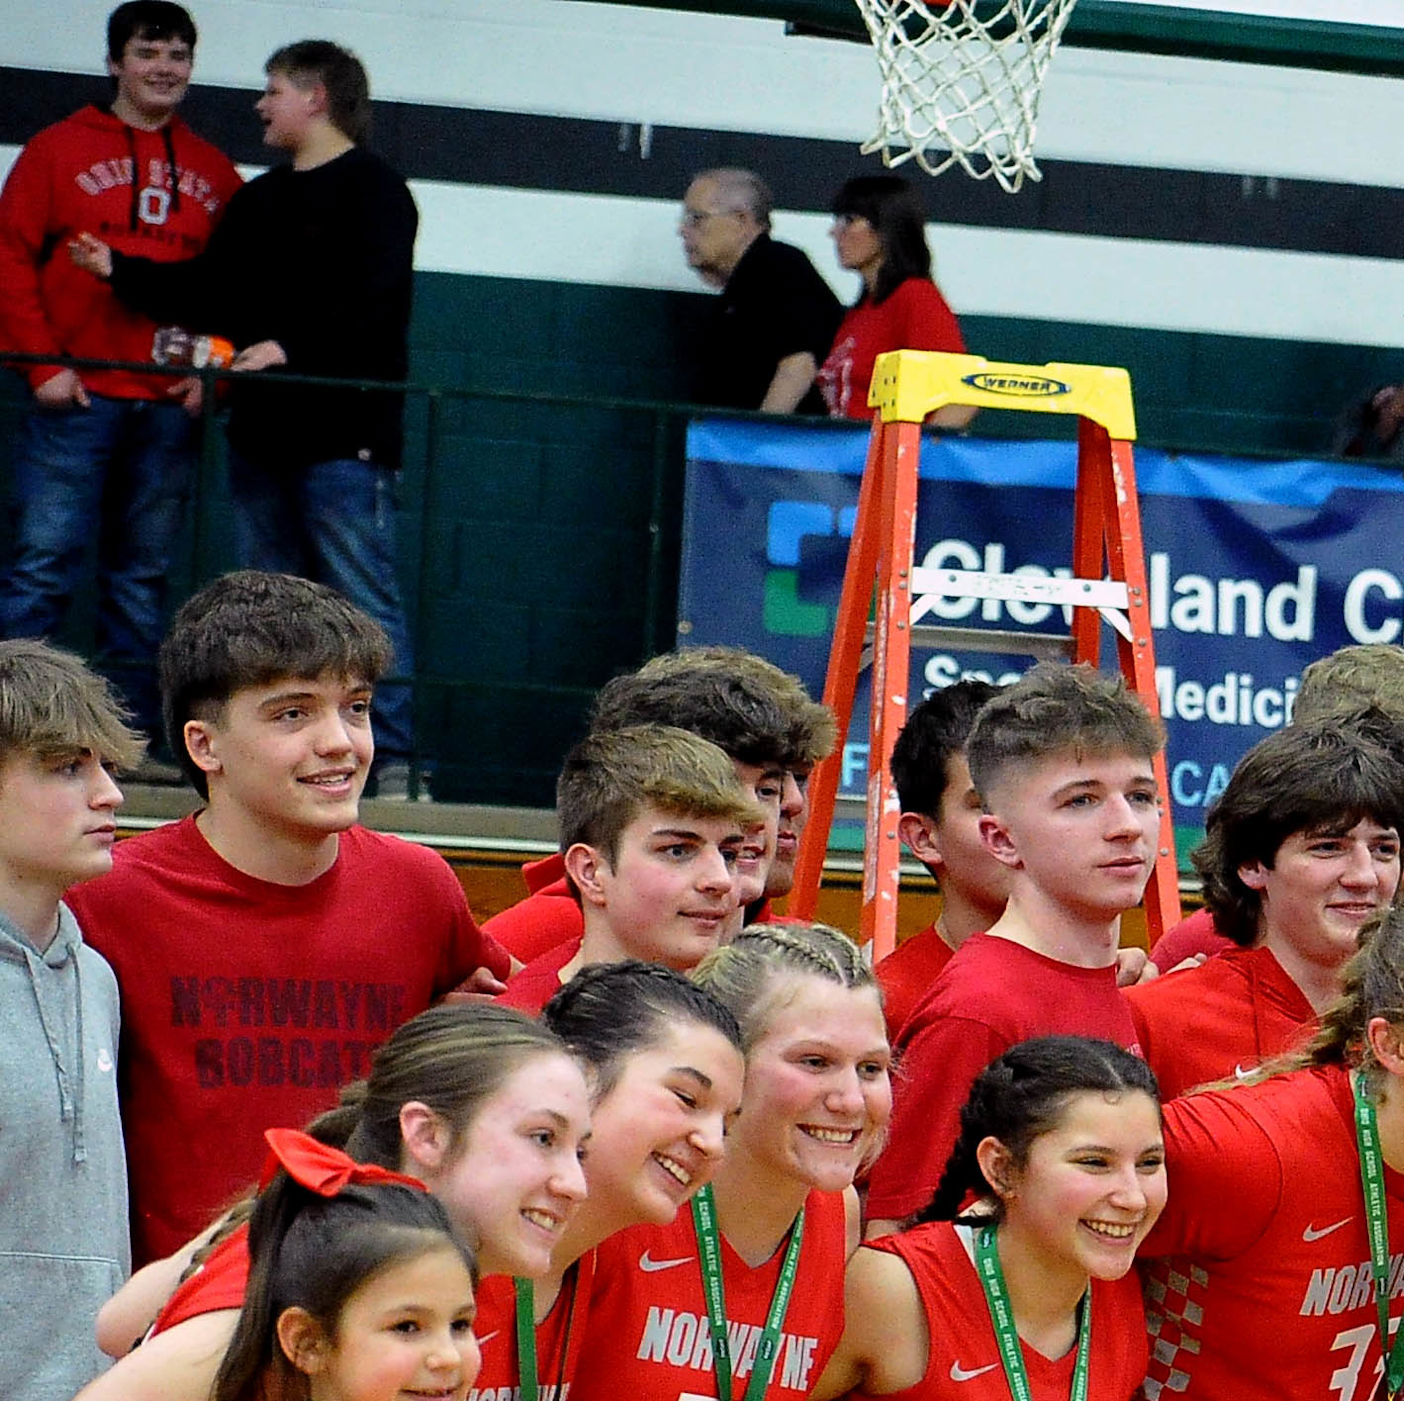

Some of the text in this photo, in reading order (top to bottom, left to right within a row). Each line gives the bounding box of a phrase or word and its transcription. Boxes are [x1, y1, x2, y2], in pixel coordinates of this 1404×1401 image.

[986, 377, 1051, 393] WERNER
[922, 539, 1317, 642] Cleland
[196, 1036, 385, 1089] BOBCAT
